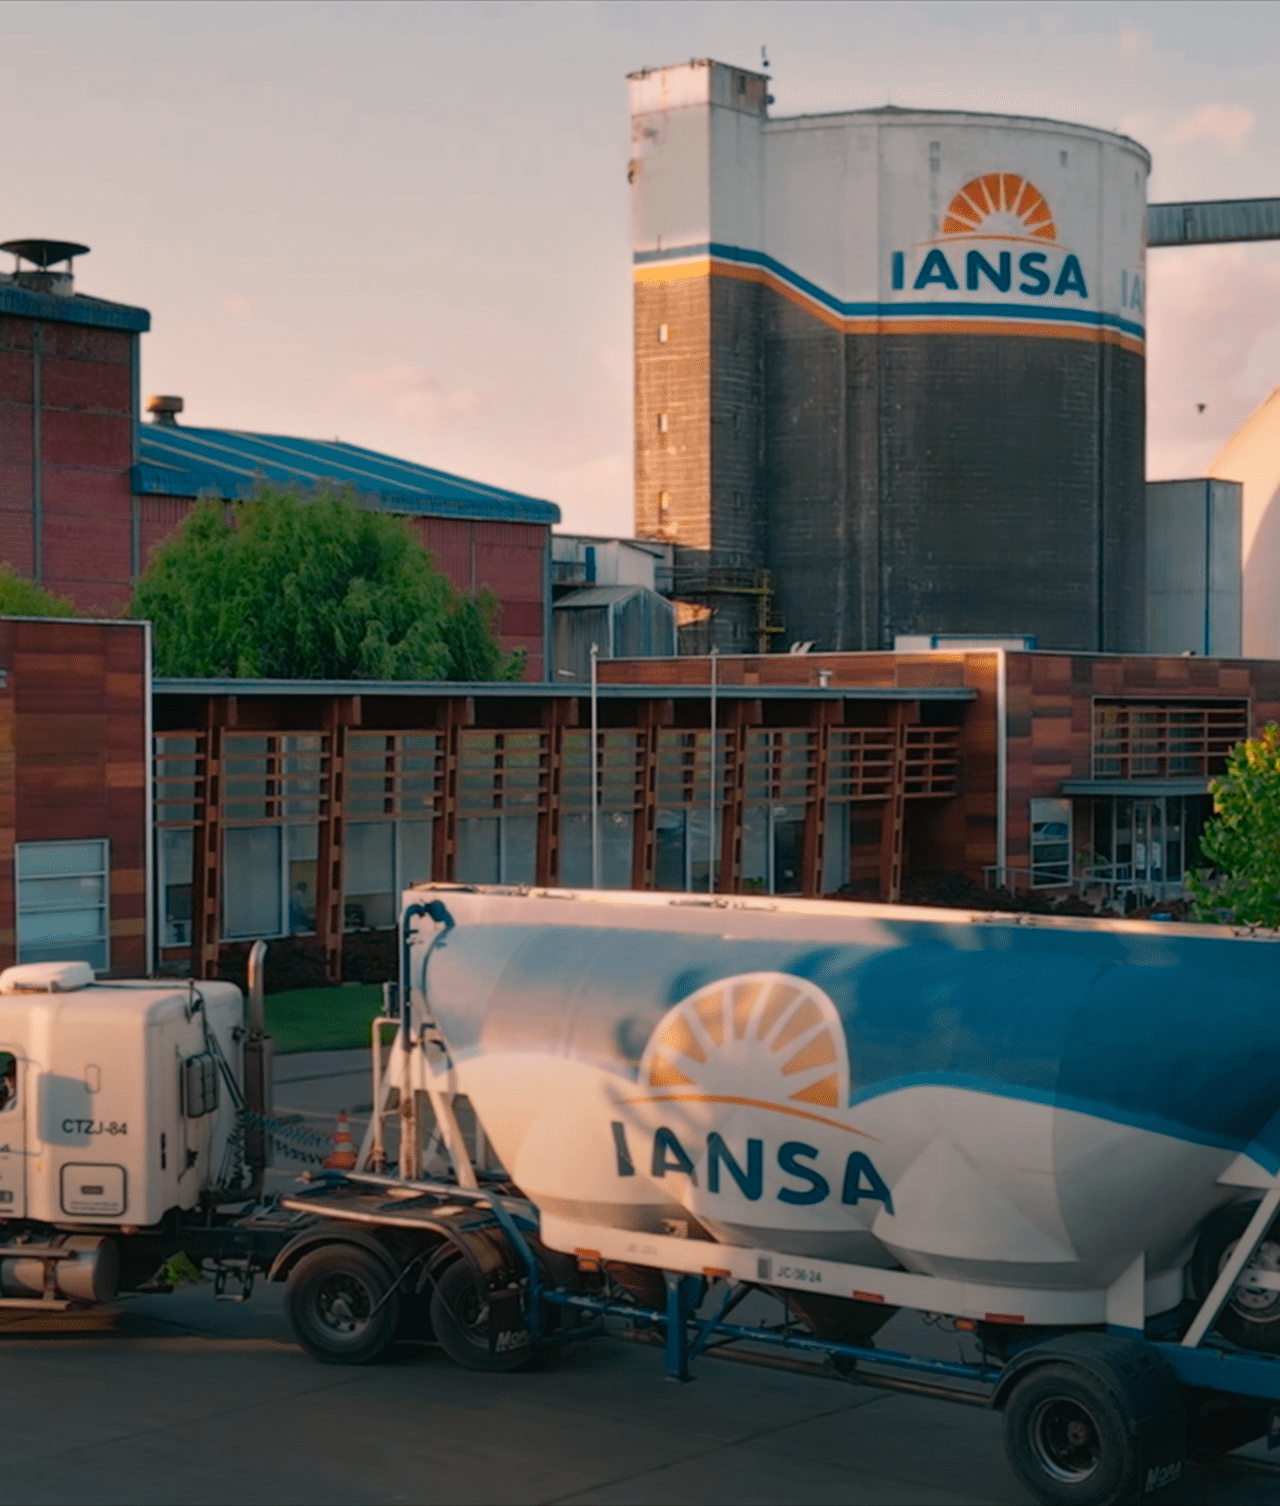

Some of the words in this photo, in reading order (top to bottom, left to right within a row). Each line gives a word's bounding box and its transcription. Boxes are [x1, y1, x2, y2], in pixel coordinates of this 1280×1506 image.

[891, 249, 1088, 298] IANSA
[61, 1119, 128, 1136] CTZJ-84
[611, 1120, 896, 1217] IANSA
